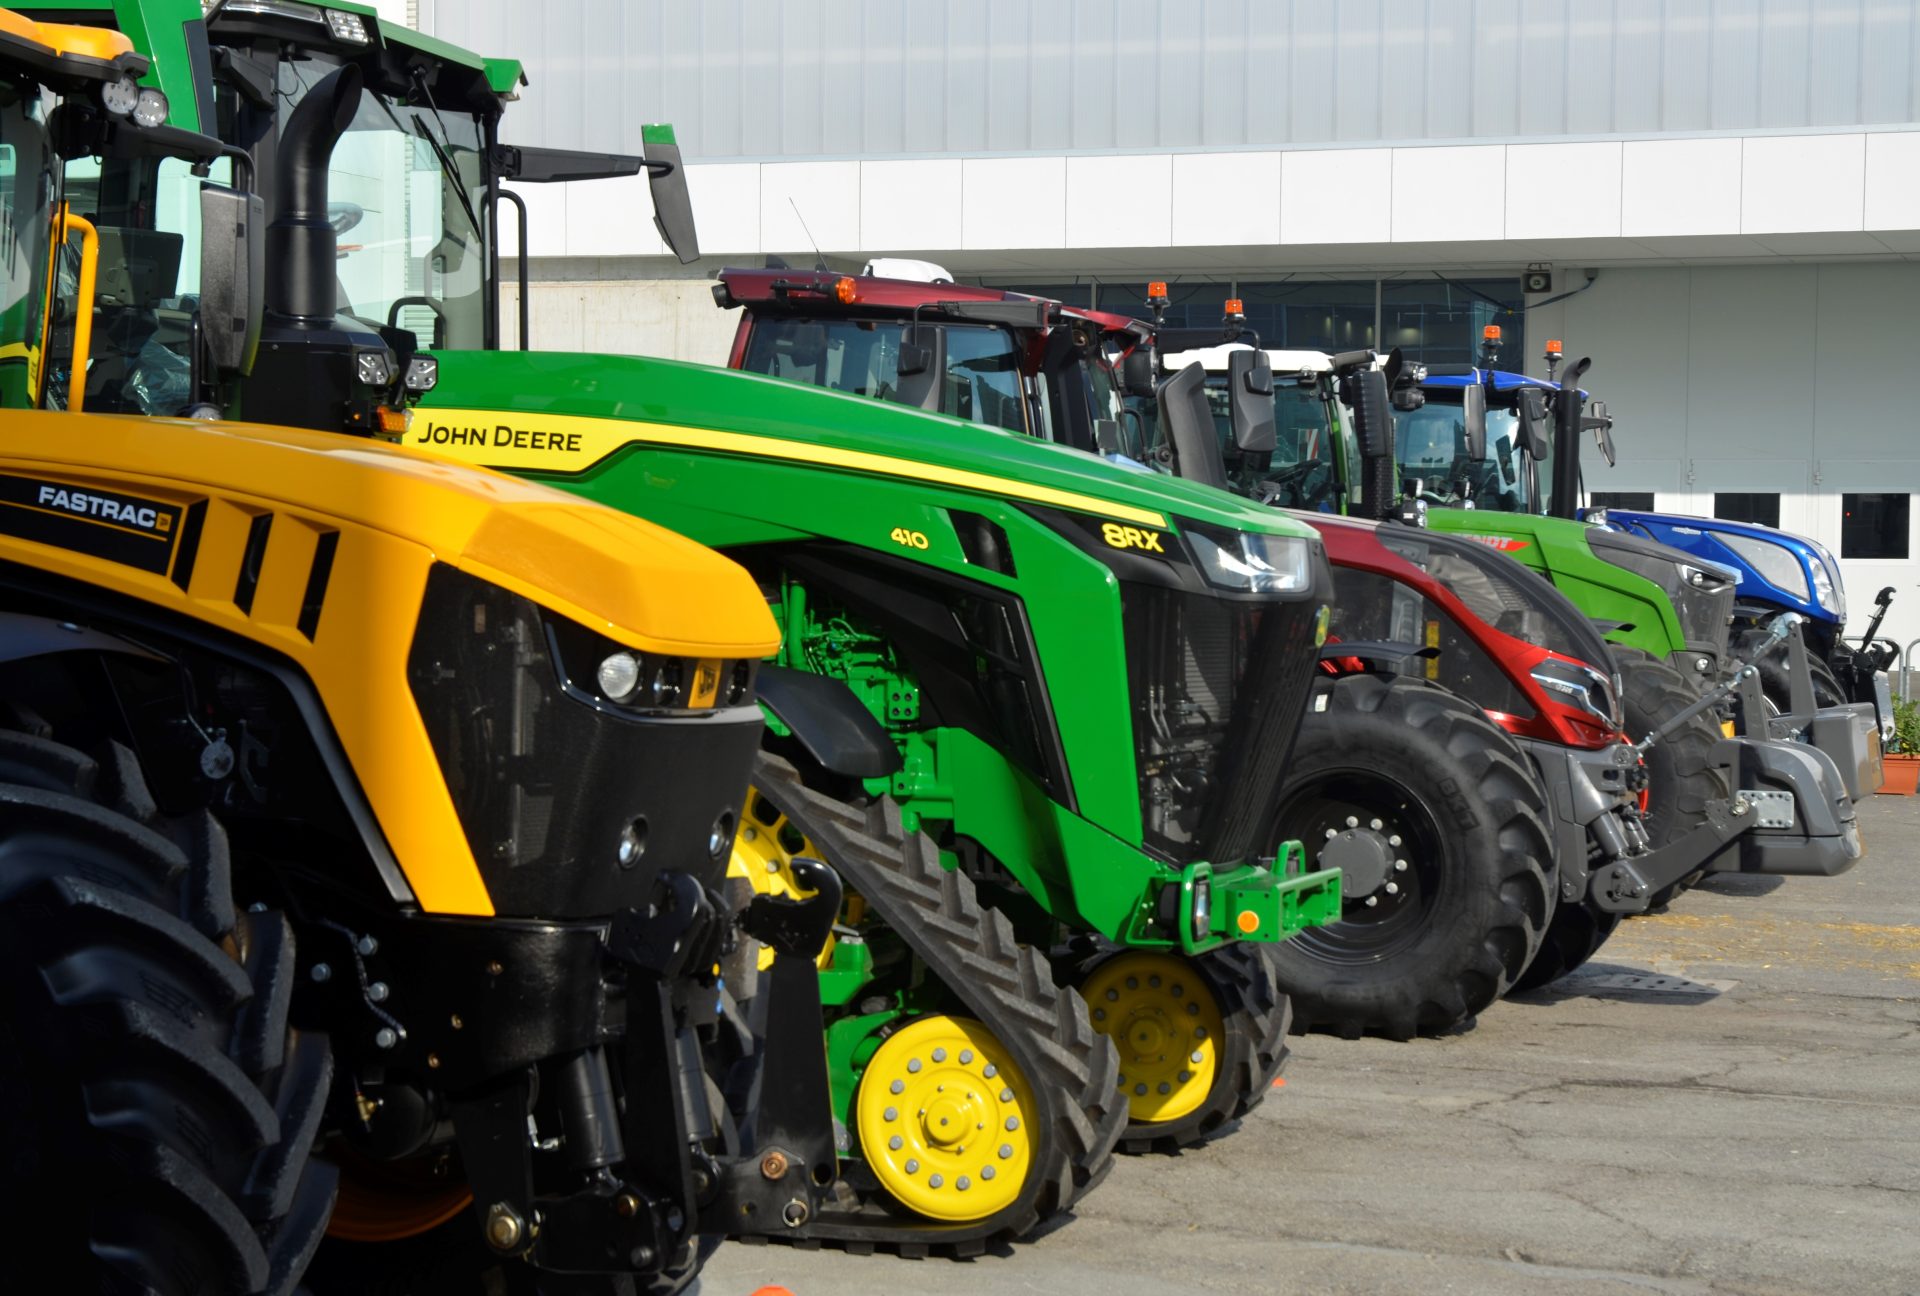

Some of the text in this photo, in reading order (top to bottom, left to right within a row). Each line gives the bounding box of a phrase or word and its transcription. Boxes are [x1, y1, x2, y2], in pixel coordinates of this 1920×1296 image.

[418, 422, 582, 452] JOHN DEERE
[38, 486, 157, 528] FASTRAC
[890, 527, 929, 550] 410
[1101, 522, 1165, 553] 8RX
[1452, 532, 1513, 549] NDT
[1439, 777, 1481, 831] BKT
